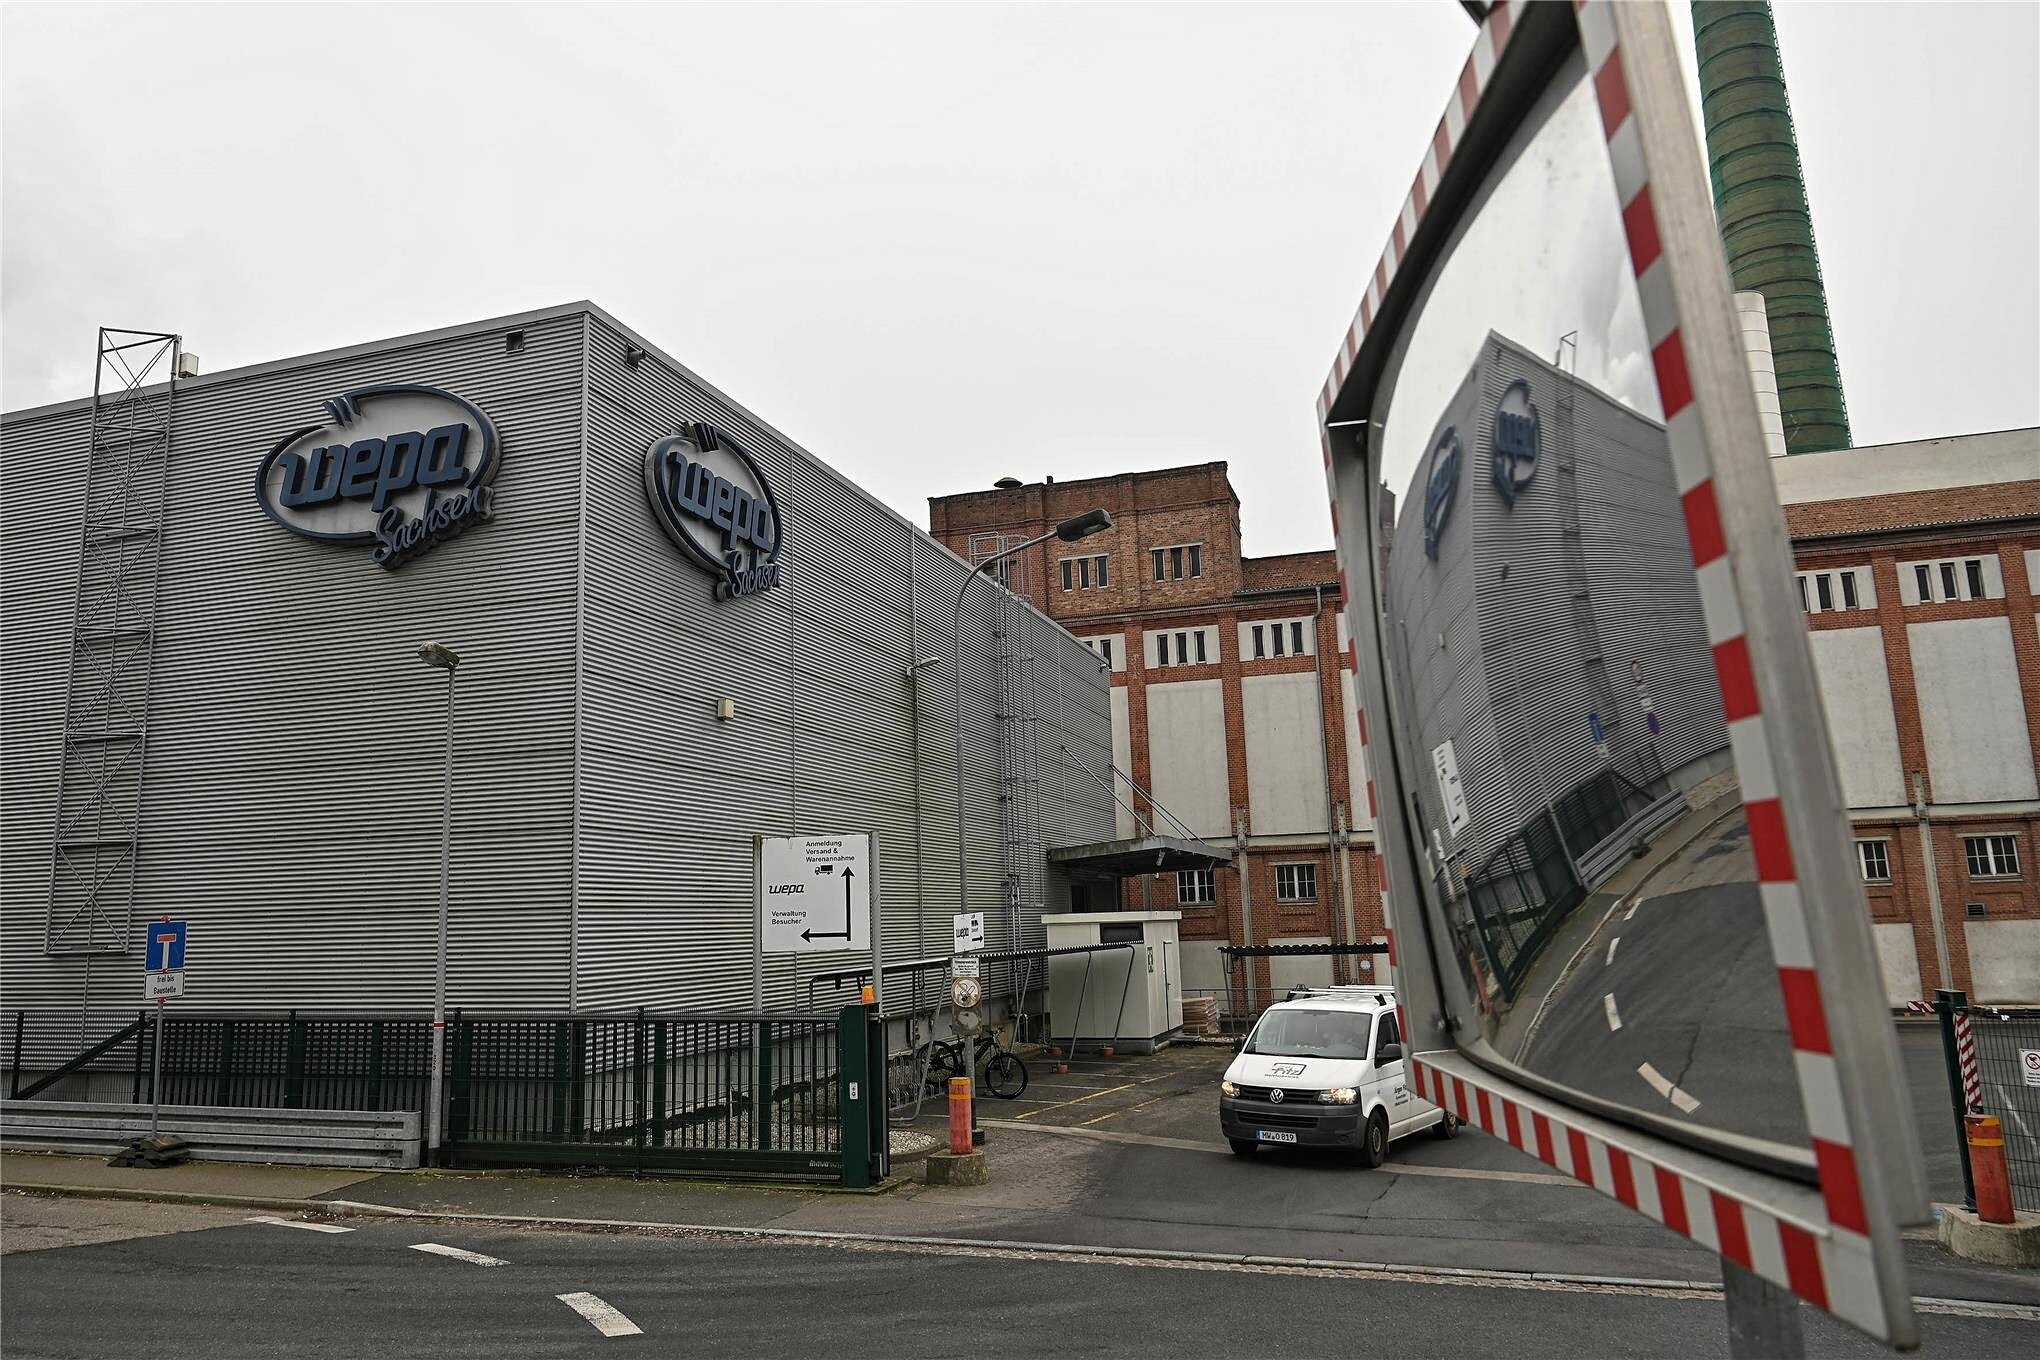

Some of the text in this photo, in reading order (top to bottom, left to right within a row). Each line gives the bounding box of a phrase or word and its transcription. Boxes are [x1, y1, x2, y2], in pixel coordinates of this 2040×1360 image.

[279, 423, 470, 513] wepa
[669, 451, 775, 554] wepa
[371, 487, 492, 566] Sachsen
[726, 550, 780, 598] Sachsen
[805, 840, 843, 848] Anmeldung
[805, 855, 855, 863] Warenannahme
[768, 884, 805, 896] wepa
[153, 986, 177, 995] Baustelle
